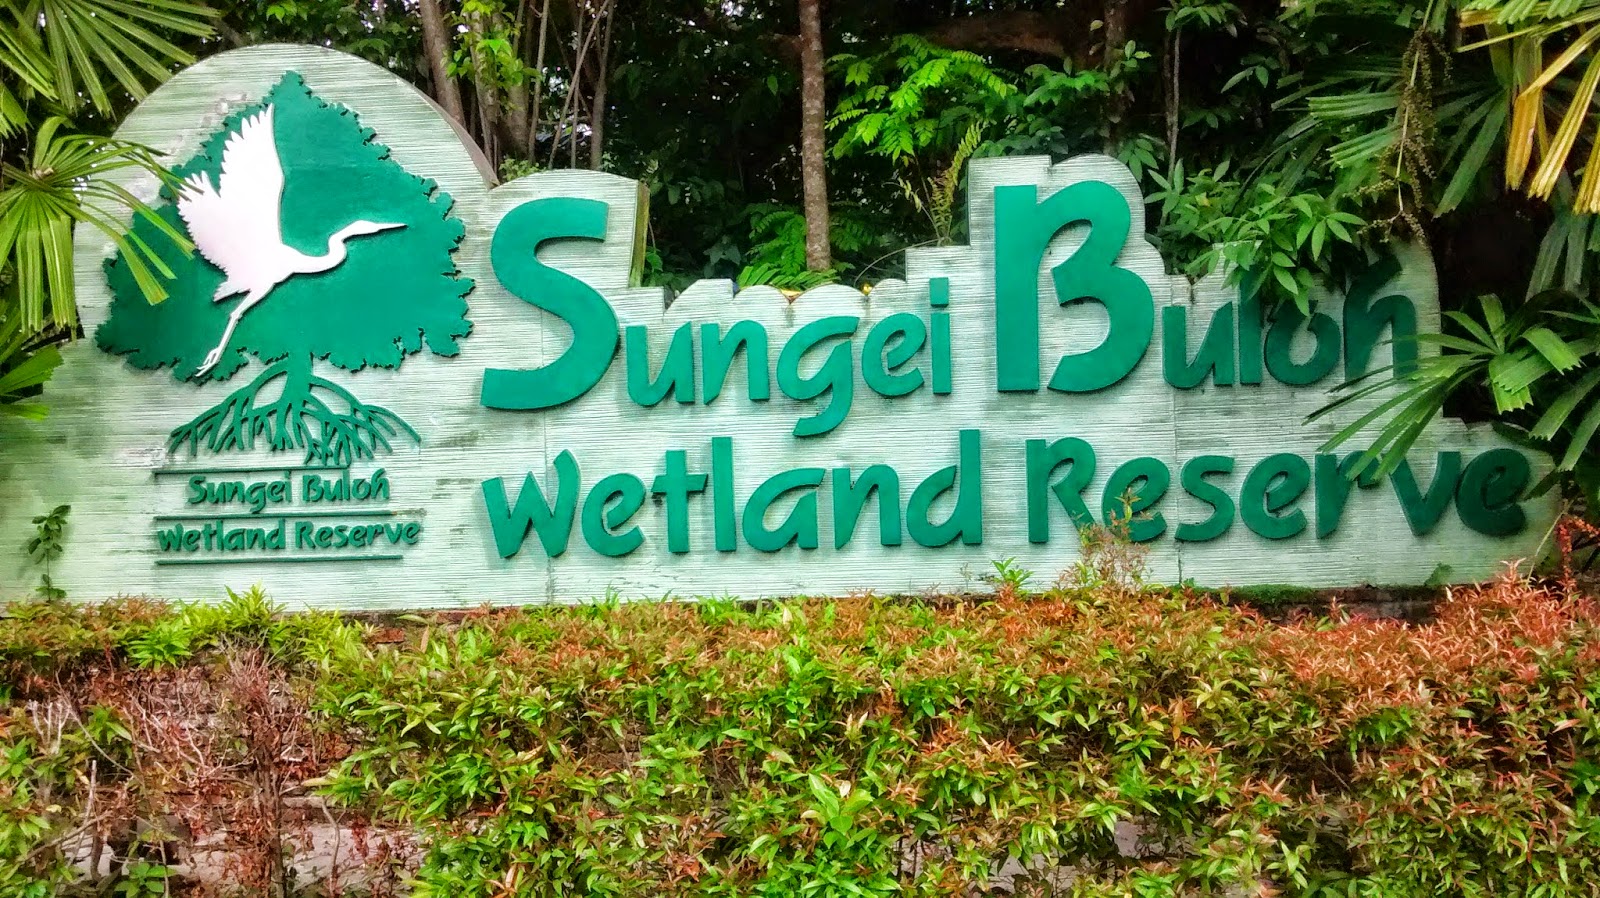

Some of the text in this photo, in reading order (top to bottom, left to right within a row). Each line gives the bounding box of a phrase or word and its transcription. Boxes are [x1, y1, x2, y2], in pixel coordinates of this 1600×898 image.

[480, 180, 1418, 436] Sungei Buloh
[187, 467, 390, 514] Sungei Buloh
[481, 429, 1531, 559] Wetland Reserve
[157, 519, 421, 551] Wetland Reserve
